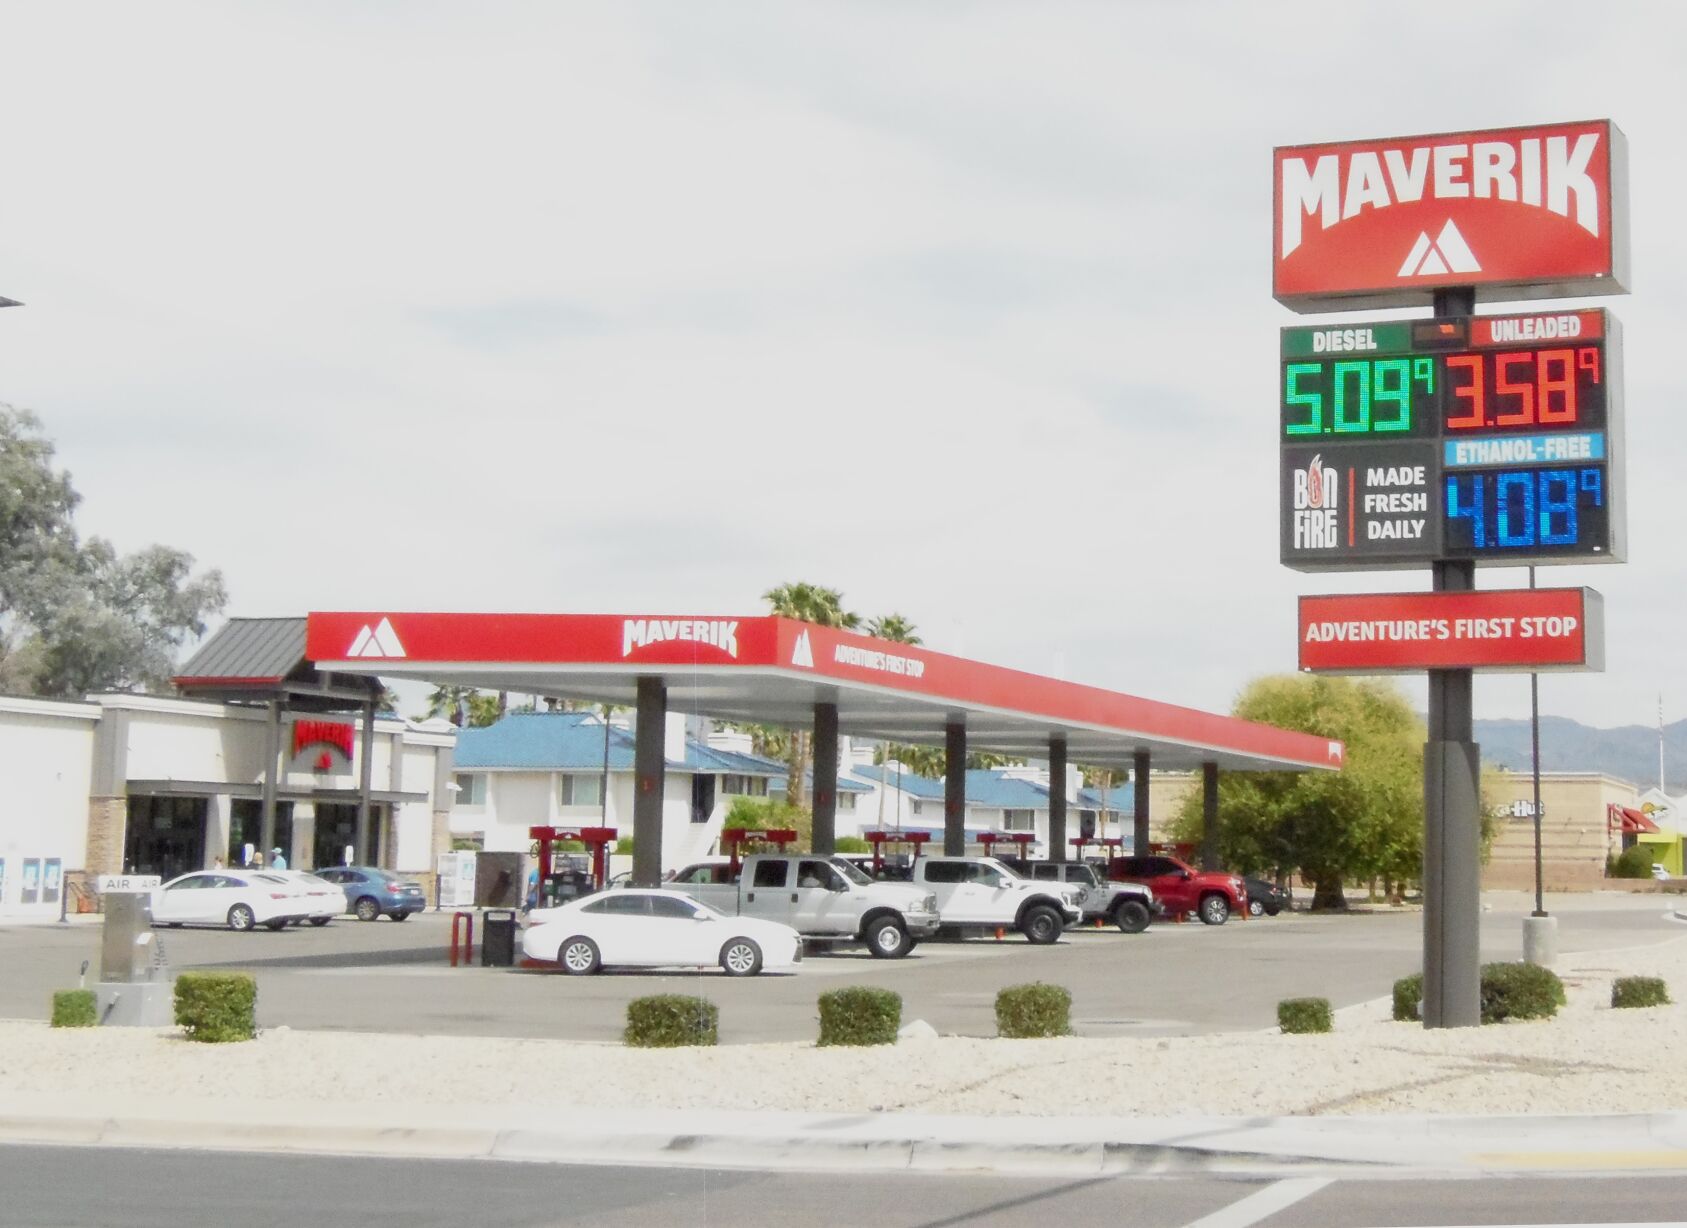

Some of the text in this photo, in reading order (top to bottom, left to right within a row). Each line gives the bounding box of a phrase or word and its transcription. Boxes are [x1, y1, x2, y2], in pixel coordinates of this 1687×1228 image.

[1282, 133, 1599, 260] MAVERIK
[1490, 316, 1581, 342] UNLEADED
[1313, 330, 1377, 352] DIESEL
[1456, 437, 1591, 464] ETHANOL-FREE
[1366, 467, 1425, 486] MADE
[1364, 494, 1427, 513] FRESH
[1367, 520, 1425, 540] DAILY
[623, 619, 739, 659] MAVERIK
[1305, 616, 1577, 642] ADVENTURE'S FIRST STOP
[906, 658, 925, 678] STOP
[106, 879, 158, 889] AIR AIR
